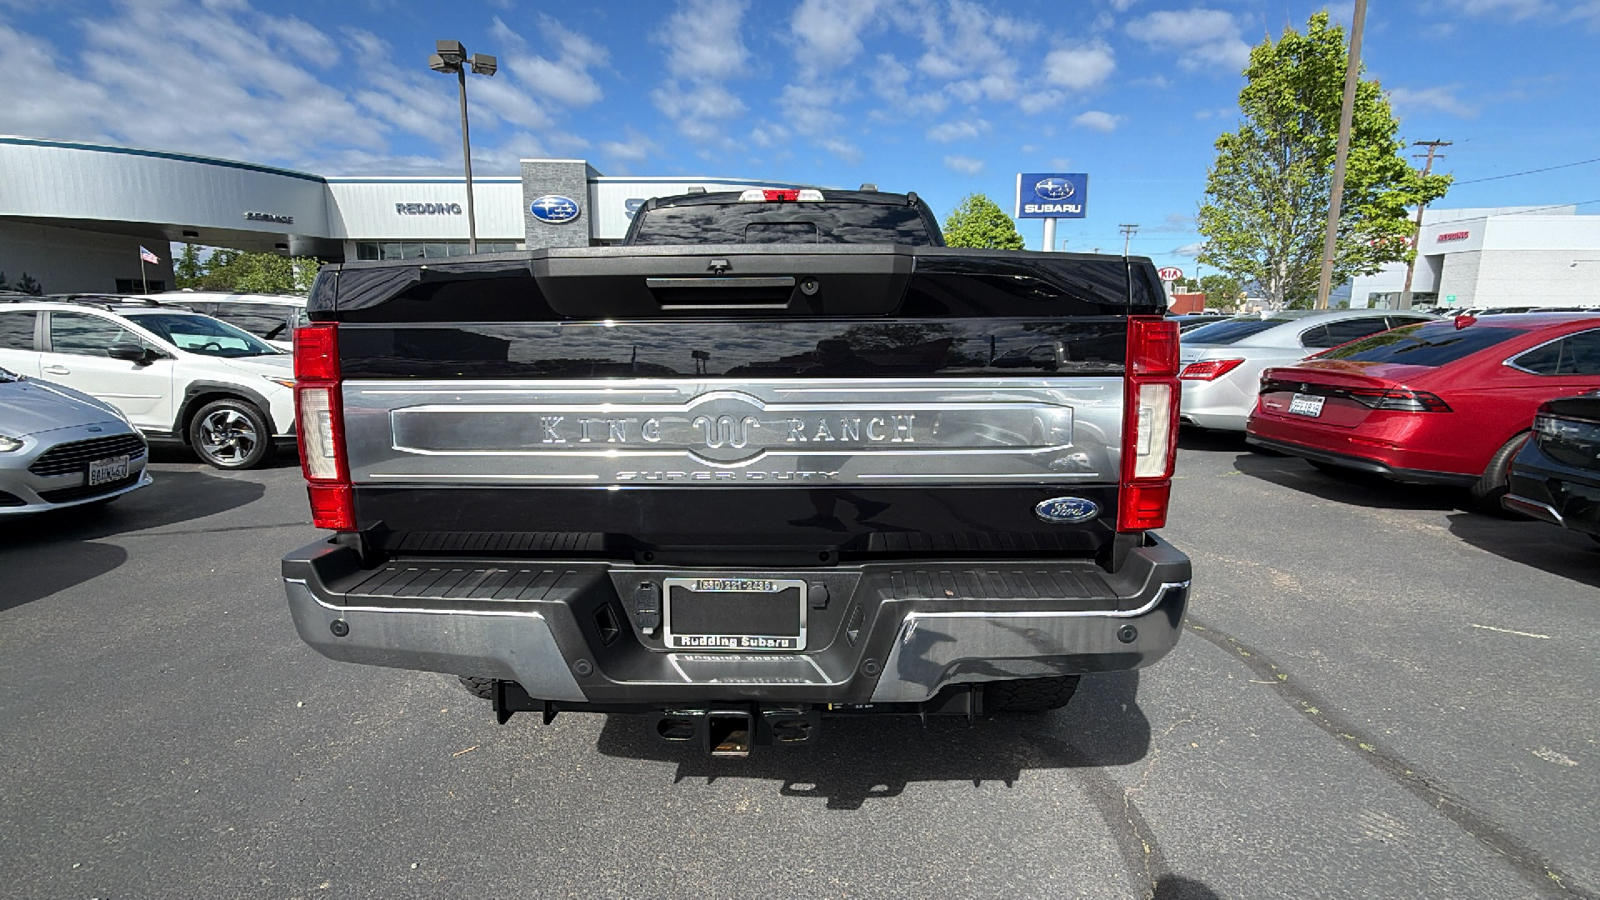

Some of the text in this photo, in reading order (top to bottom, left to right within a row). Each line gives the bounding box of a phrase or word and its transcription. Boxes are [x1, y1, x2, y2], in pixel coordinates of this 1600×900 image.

[395, 202, 462, 215] REDDING
[1024, 204, 1081, 213] SUBARU
[244, 211, 294, 225] SERVICE
[1161, 269, 1178, 279] KIA
[541, 414, 915, 443] KING RANCH
[616, 471, 840, 481] SUPER DUTY
[1050, 501, 1085, 516] Ford
[741, 637, 790, 648] Subaru
